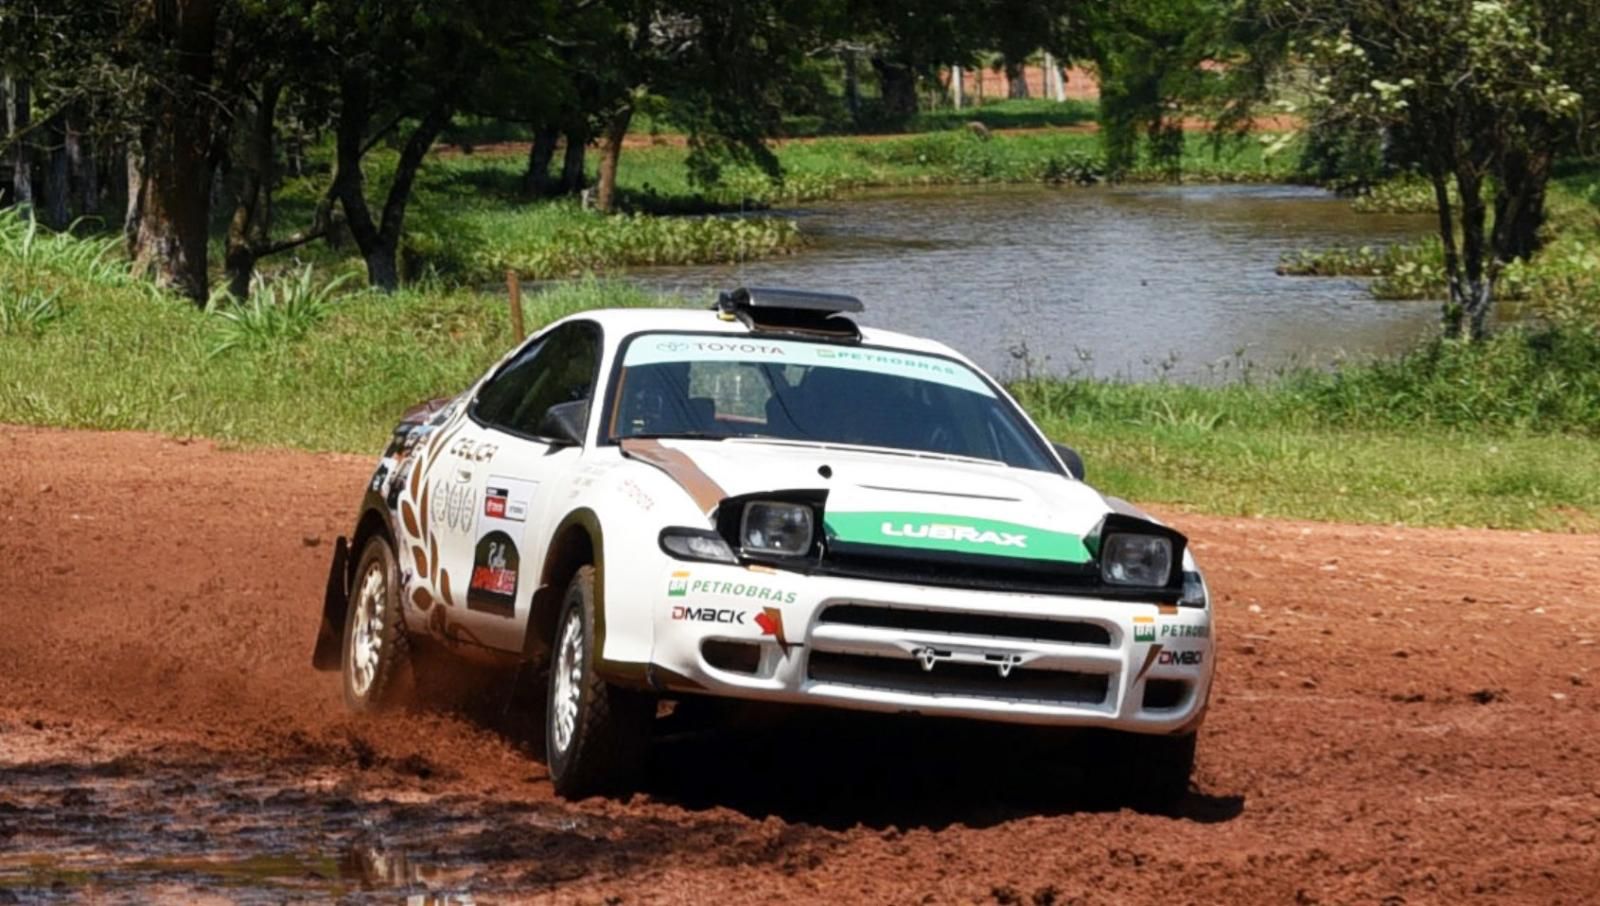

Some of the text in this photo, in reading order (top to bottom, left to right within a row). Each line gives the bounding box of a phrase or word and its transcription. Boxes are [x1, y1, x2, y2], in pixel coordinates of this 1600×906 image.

[695, 342, 785, 355] TOYOTA
[837, 351, 955, 375] PETROBRAS
[881, 521, 1028, 549] LUBRAX
[691, 579, 798, 604] PETROBRAS
